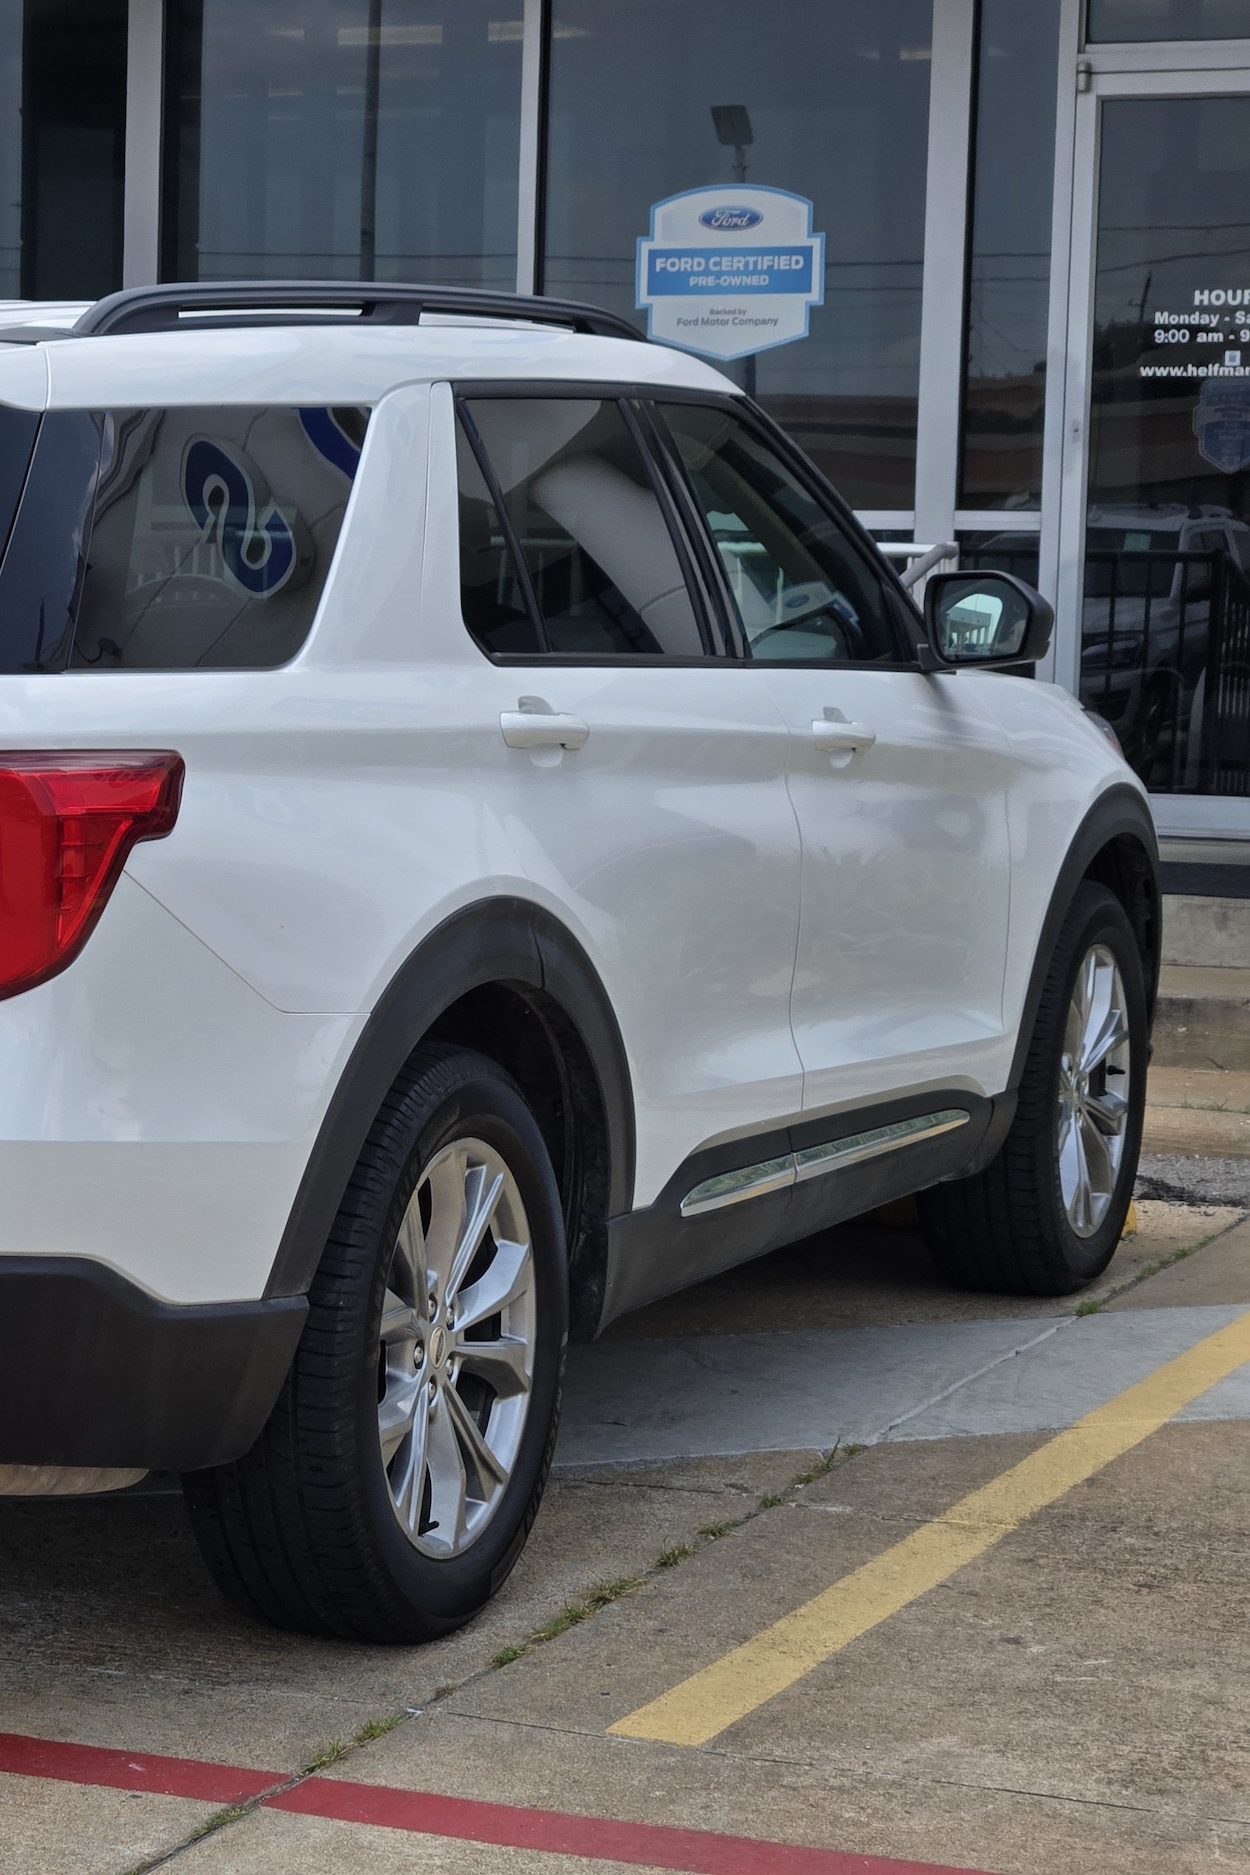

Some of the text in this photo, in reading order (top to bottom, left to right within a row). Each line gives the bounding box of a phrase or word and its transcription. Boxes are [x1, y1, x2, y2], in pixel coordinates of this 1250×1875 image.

[711, 210, 751, 227] Ford
[655, 255, 804, 272] FORD CERTIFIED
[689, 275, 770, 287] PRE-OWNED
[709, 308, 747, 317] Backed by
[1154, 310, 1220, 327] Monday
[677, 317, 779, 328] Ford Motor Company
[1154, 329, 1190, 343] 9:00
[1196, 331, 1224, 342] am
